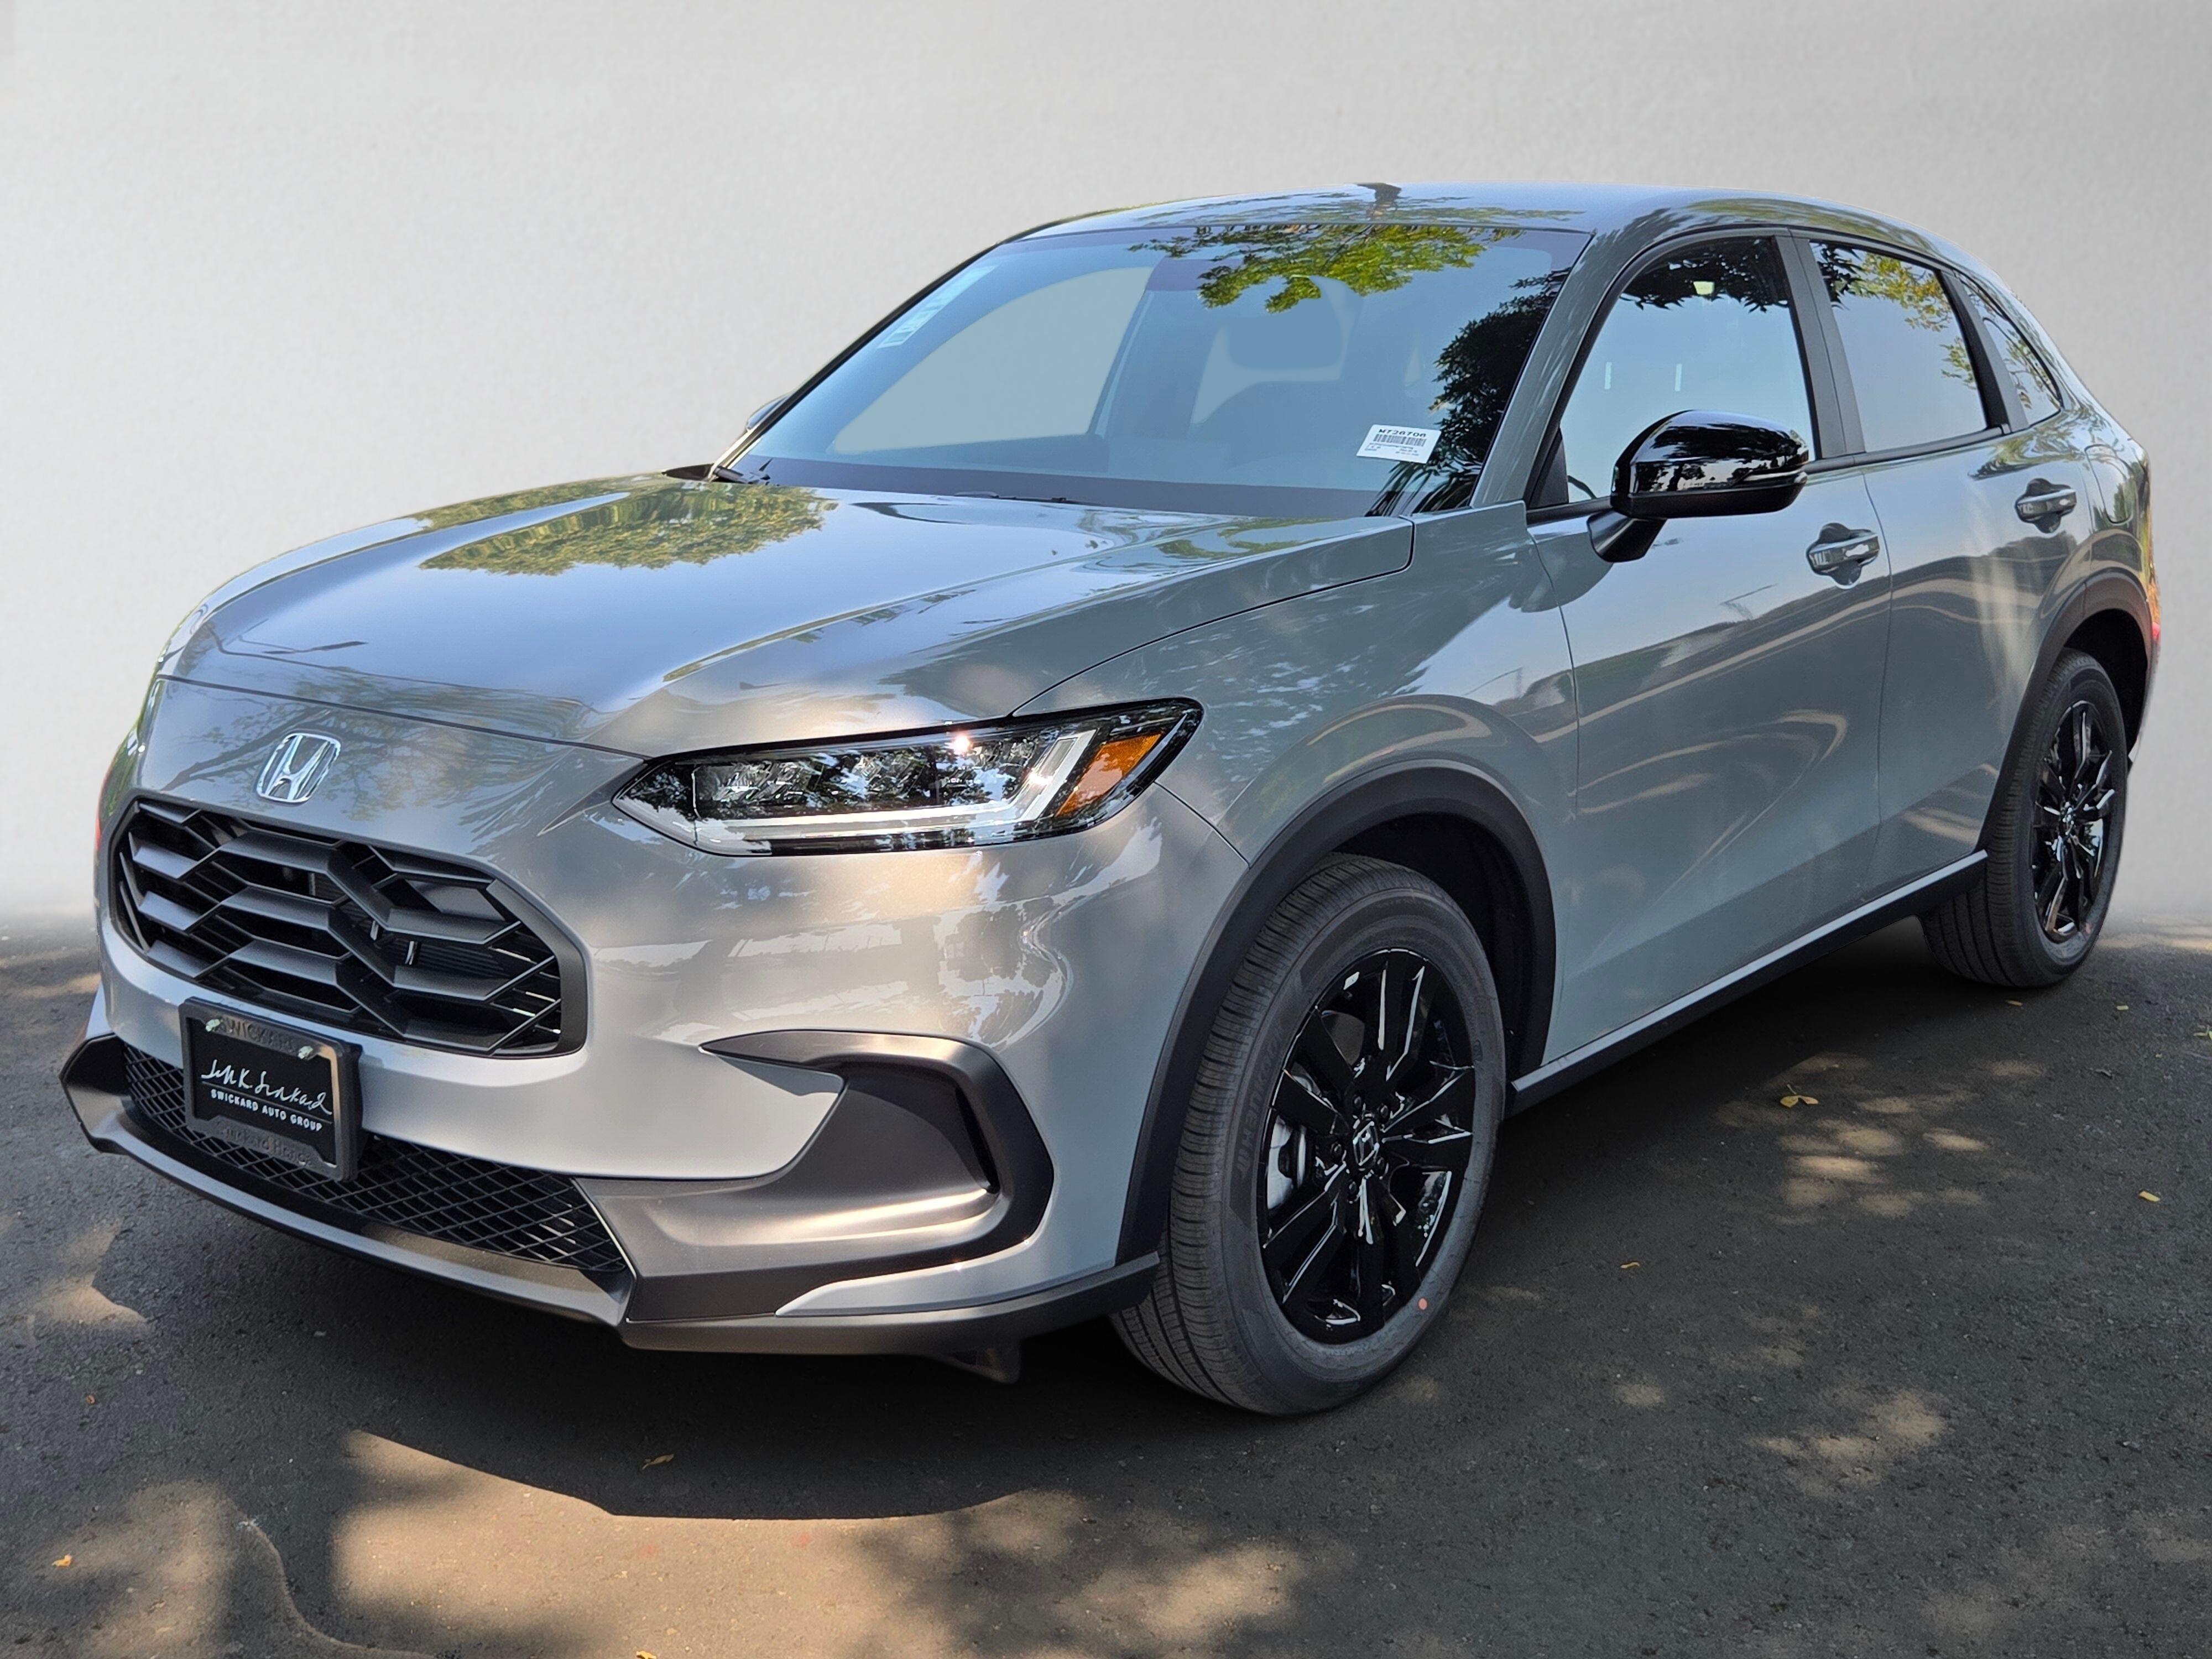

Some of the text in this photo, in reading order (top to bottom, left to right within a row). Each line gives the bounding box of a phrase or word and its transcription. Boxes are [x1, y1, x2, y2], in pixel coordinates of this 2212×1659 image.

[211, 1089, 322, 1132] SWICKARD AUTO GROUP
